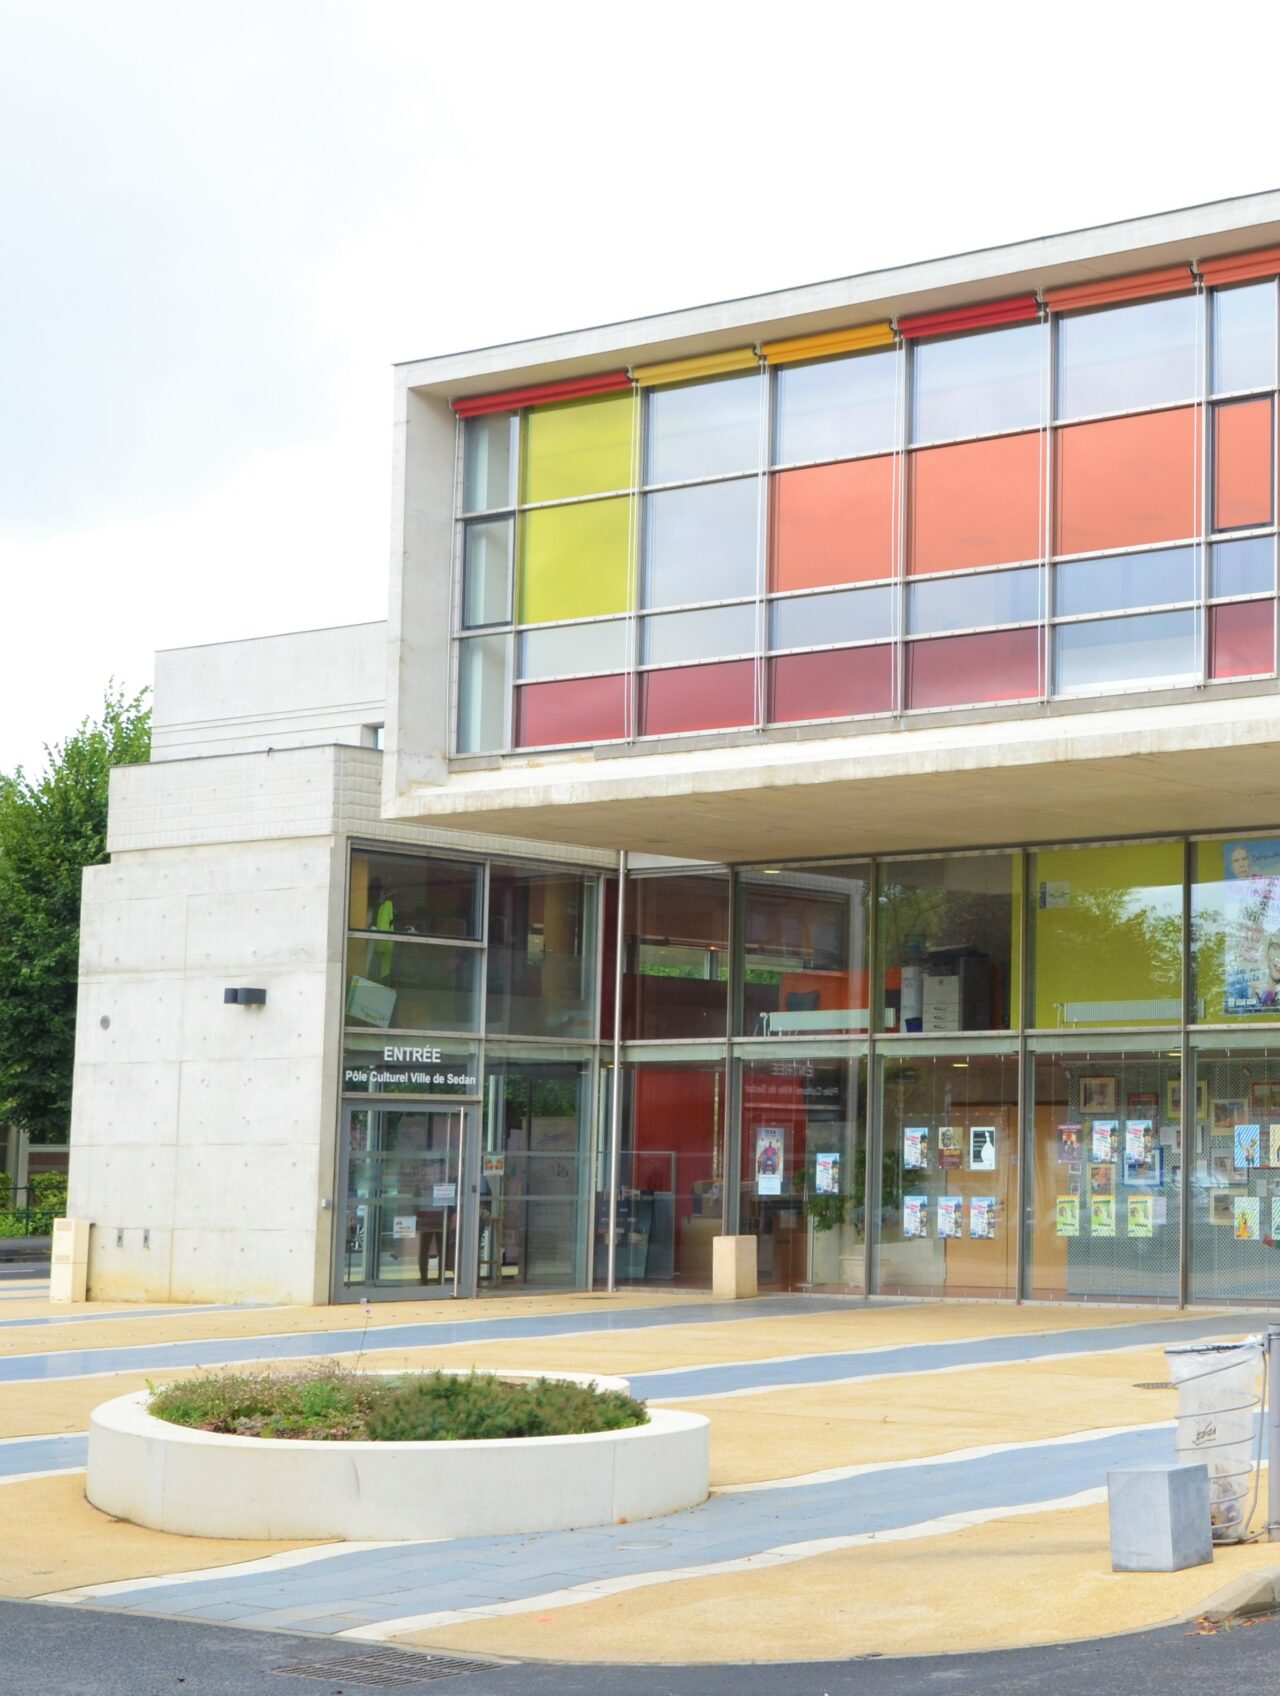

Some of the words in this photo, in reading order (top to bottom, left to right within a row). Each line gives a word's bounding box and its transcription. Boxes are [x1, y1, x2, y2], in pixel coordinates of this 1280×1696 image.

[383, 1045, 441, 1063] ENTRÉE
[345, 1070, 367, 1082] Pôle
[369, 1071, 408, 1083] Culturel
[410, 1072, 431, 1084] Ville
[433, 1073, 445, 1084] de
[447, 1073, 476, 1085] Sedan
